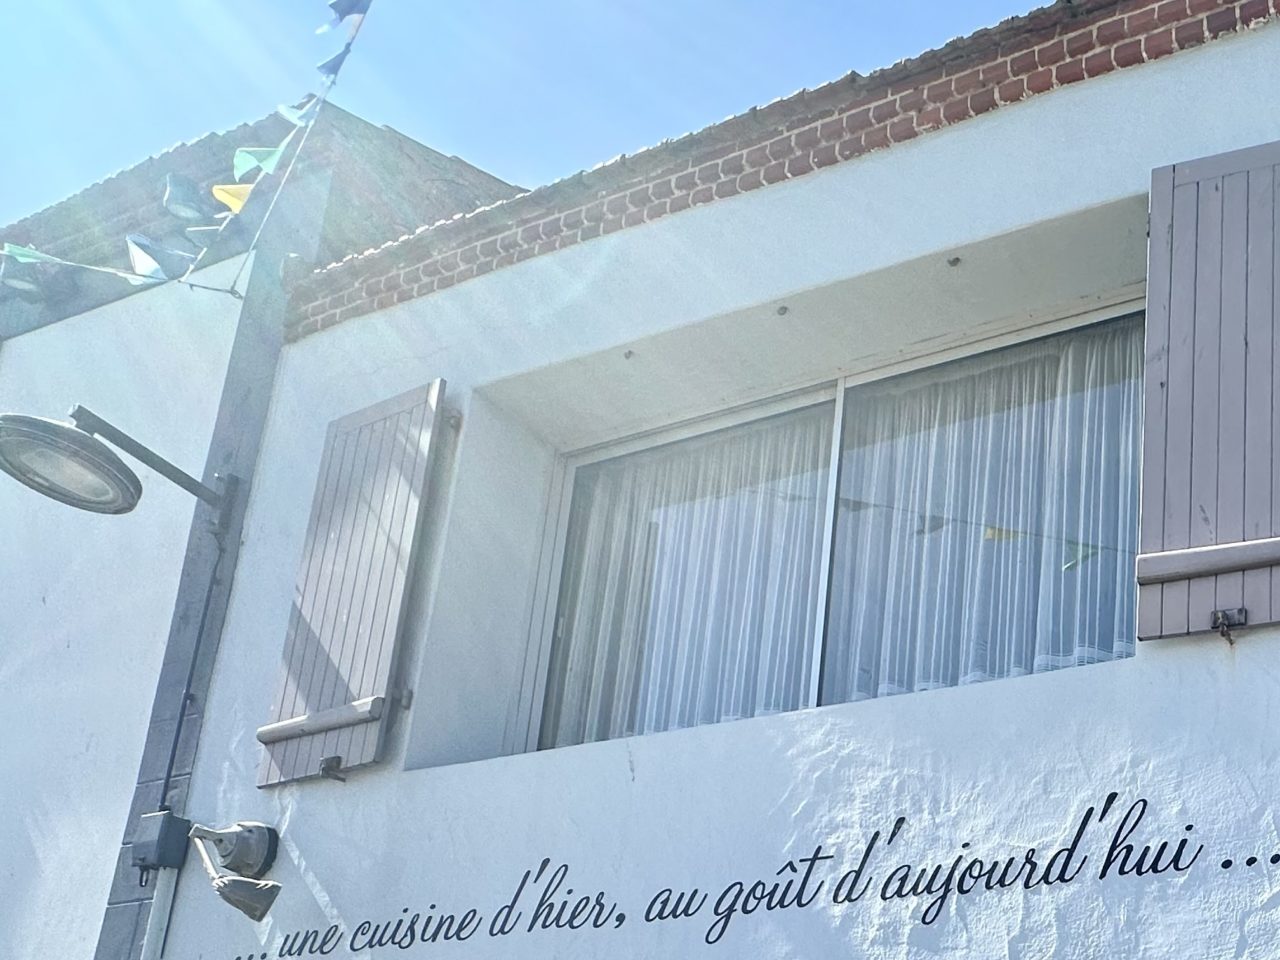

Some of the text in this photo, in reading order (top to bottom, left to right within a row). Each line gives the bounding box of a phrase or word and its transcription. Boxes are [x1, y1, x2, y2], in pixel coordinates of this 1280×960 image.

[278, 925, 344, 957] une
[349, 903, 483, 952] cuisine
[488, 857, 626, 937] d'hier,
[644, 888, 709, 923] au
[705, 841, 835, 945] goût
[832, 791, 1204, 926] d'aujourd'hui
